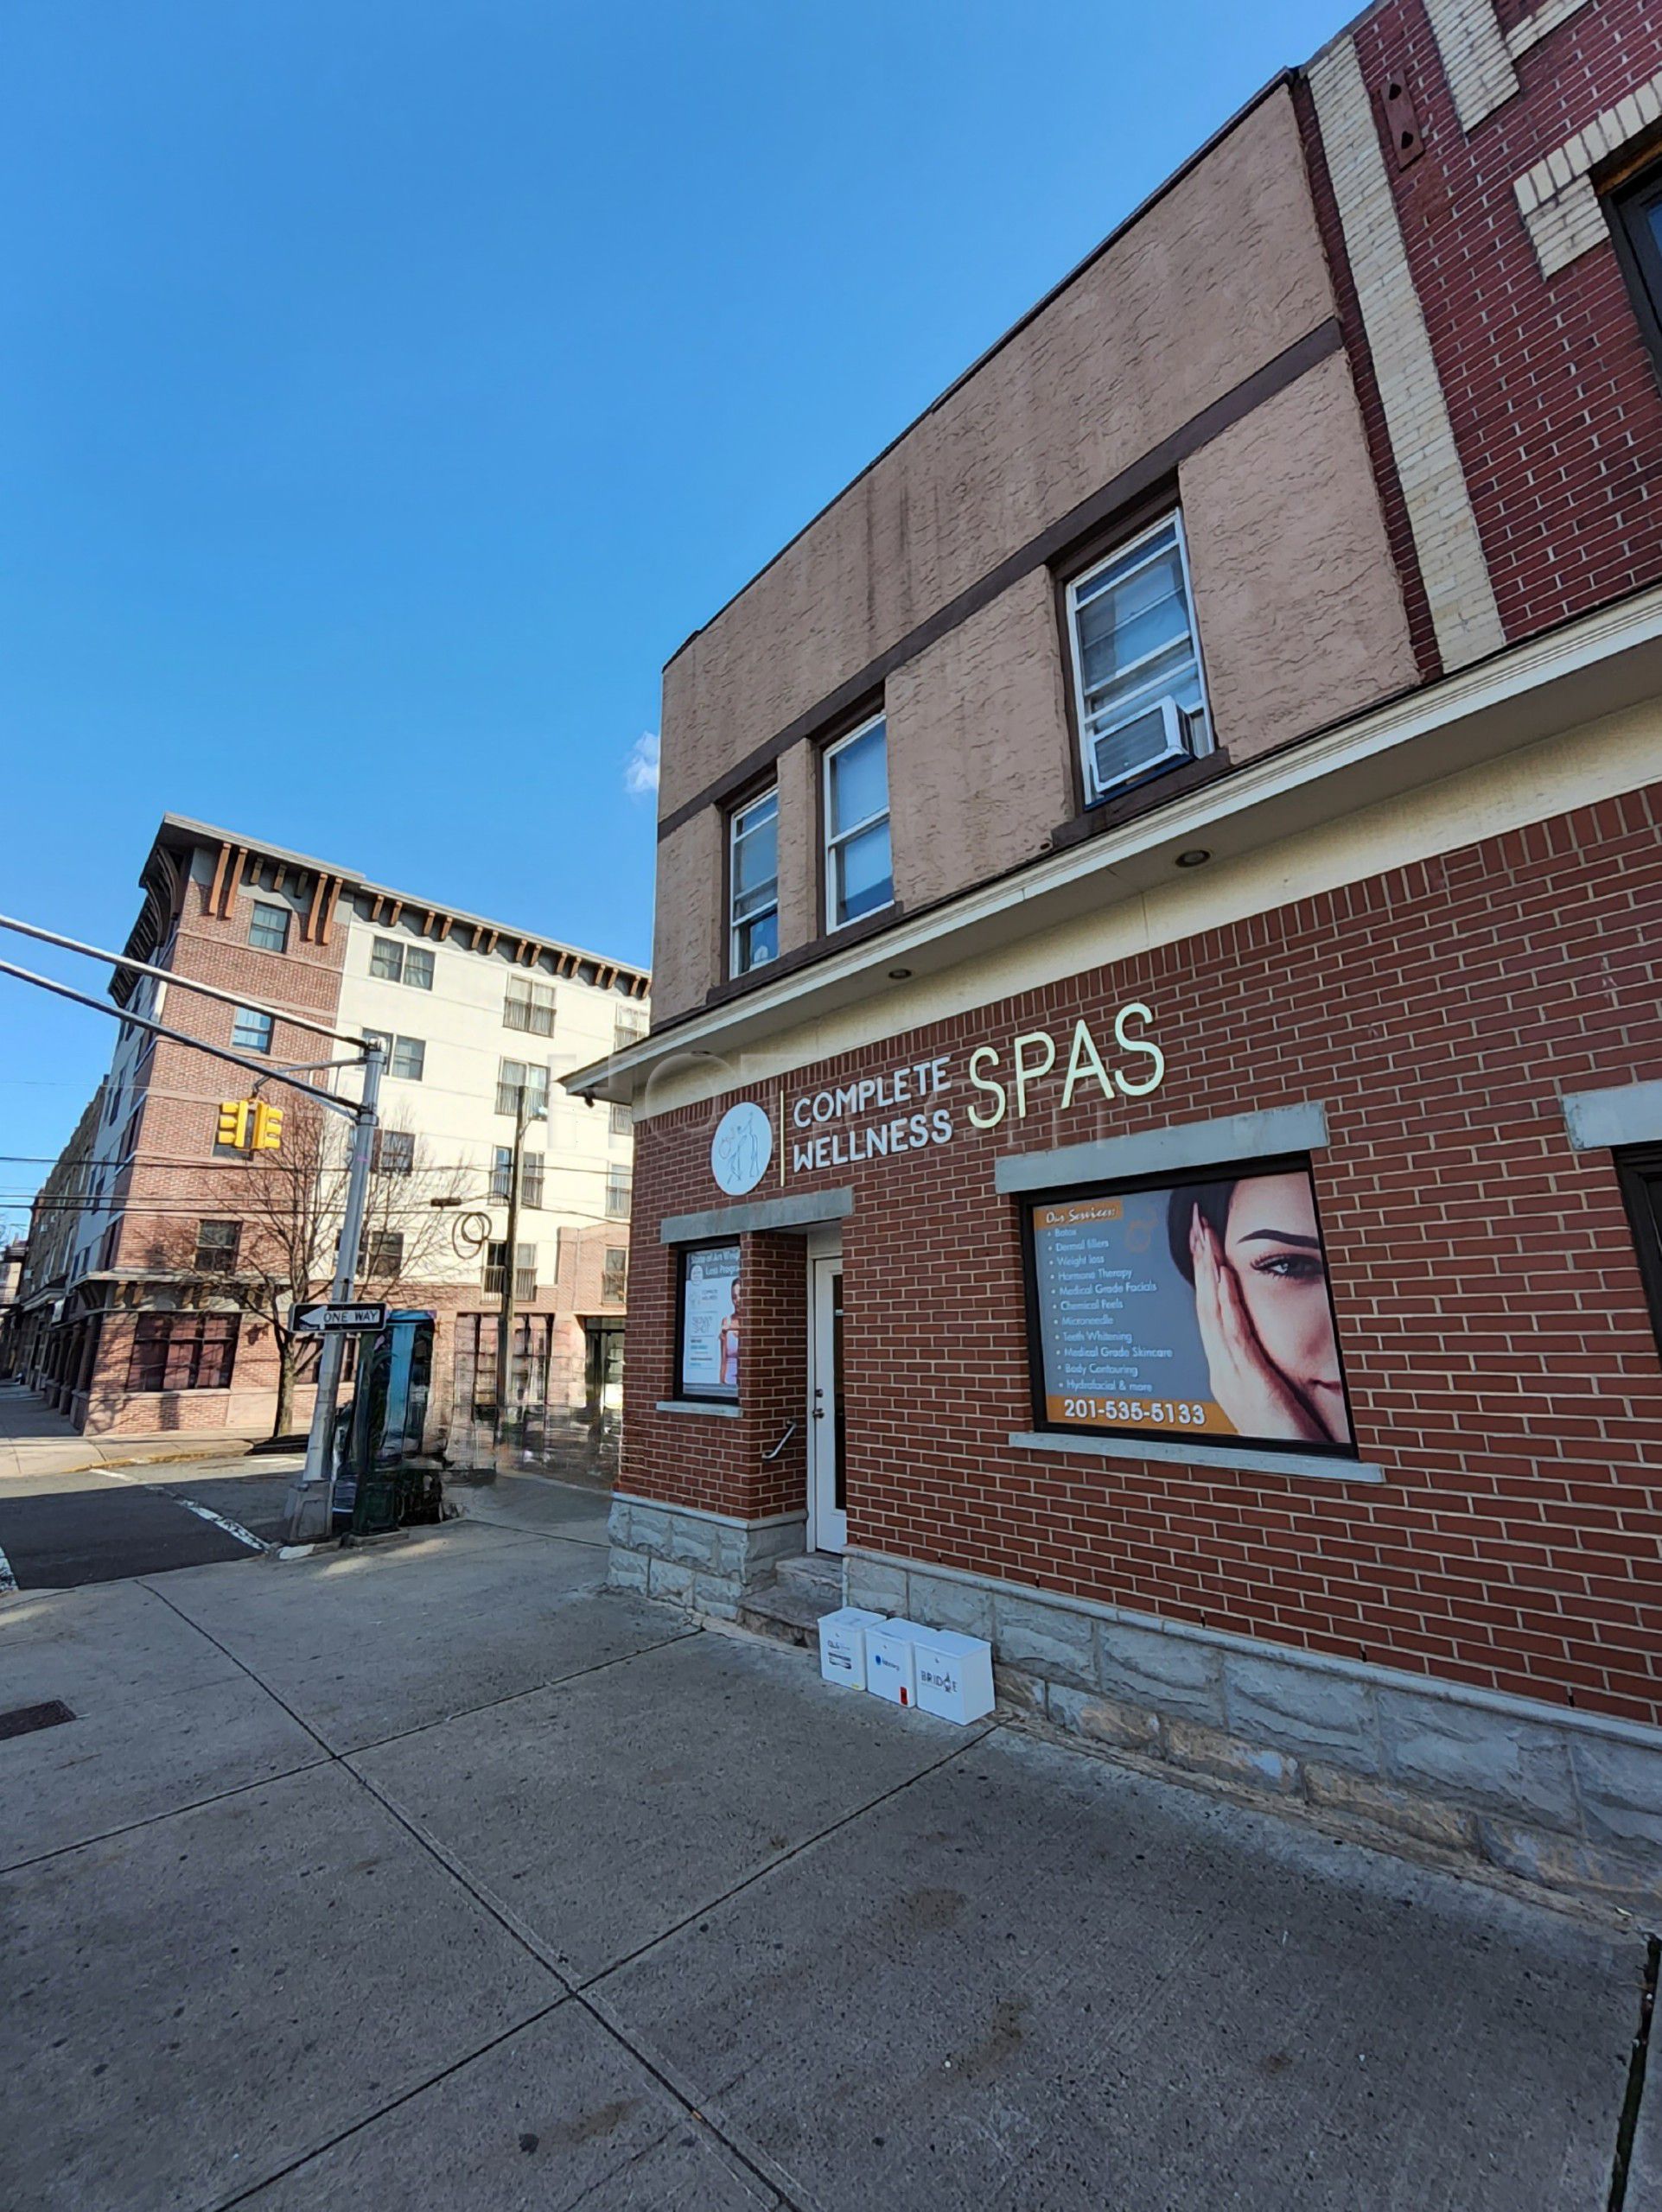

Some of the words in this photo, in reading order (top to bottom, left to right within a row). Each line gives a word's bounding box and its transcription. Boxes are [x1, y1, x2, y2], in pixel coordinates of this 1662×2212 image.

[967, 1001, 1165, 1130] SPAS
[793, 1055, 952, 1128] COMPLETE
[793, 1109, 953, 1174] WELLNESS
[1056, 1239, 1086, 1252] Dermal
[1056, 1254, 1086, 1268] Weight
[1098, 1268, 1132, 1280] Therapy
[1059, 1283, 1092, 1295] Medical
[1095, 1282, 1124, 1294] Grade
[1125, 1279, 1157, 1293] Facials
[1060, 1298, 1100, 1311] Chemical
[1101, 1297, 1124, 1310] Peels
[323, 1311, 348, 1323] ONE
[354, 1310, 378, 1322] WAY
[1063, 1332, 1086, 1342] Teeth
[1086, 1331, 1133, 1344] Whitening
[1064, 1345, 1098, 1357] Medical
[1100, 1346, 1130, 1357] Grade
[1132, 1345, 1174, 1358] Skincare
[1065, 1363, 1086, 1376] Body
[1089, 1363, 1138, 1377] Contouring
[1129, 1383, 1153, 1392] more
[1064, 1398, 1207, 1425] 201-535-5133
